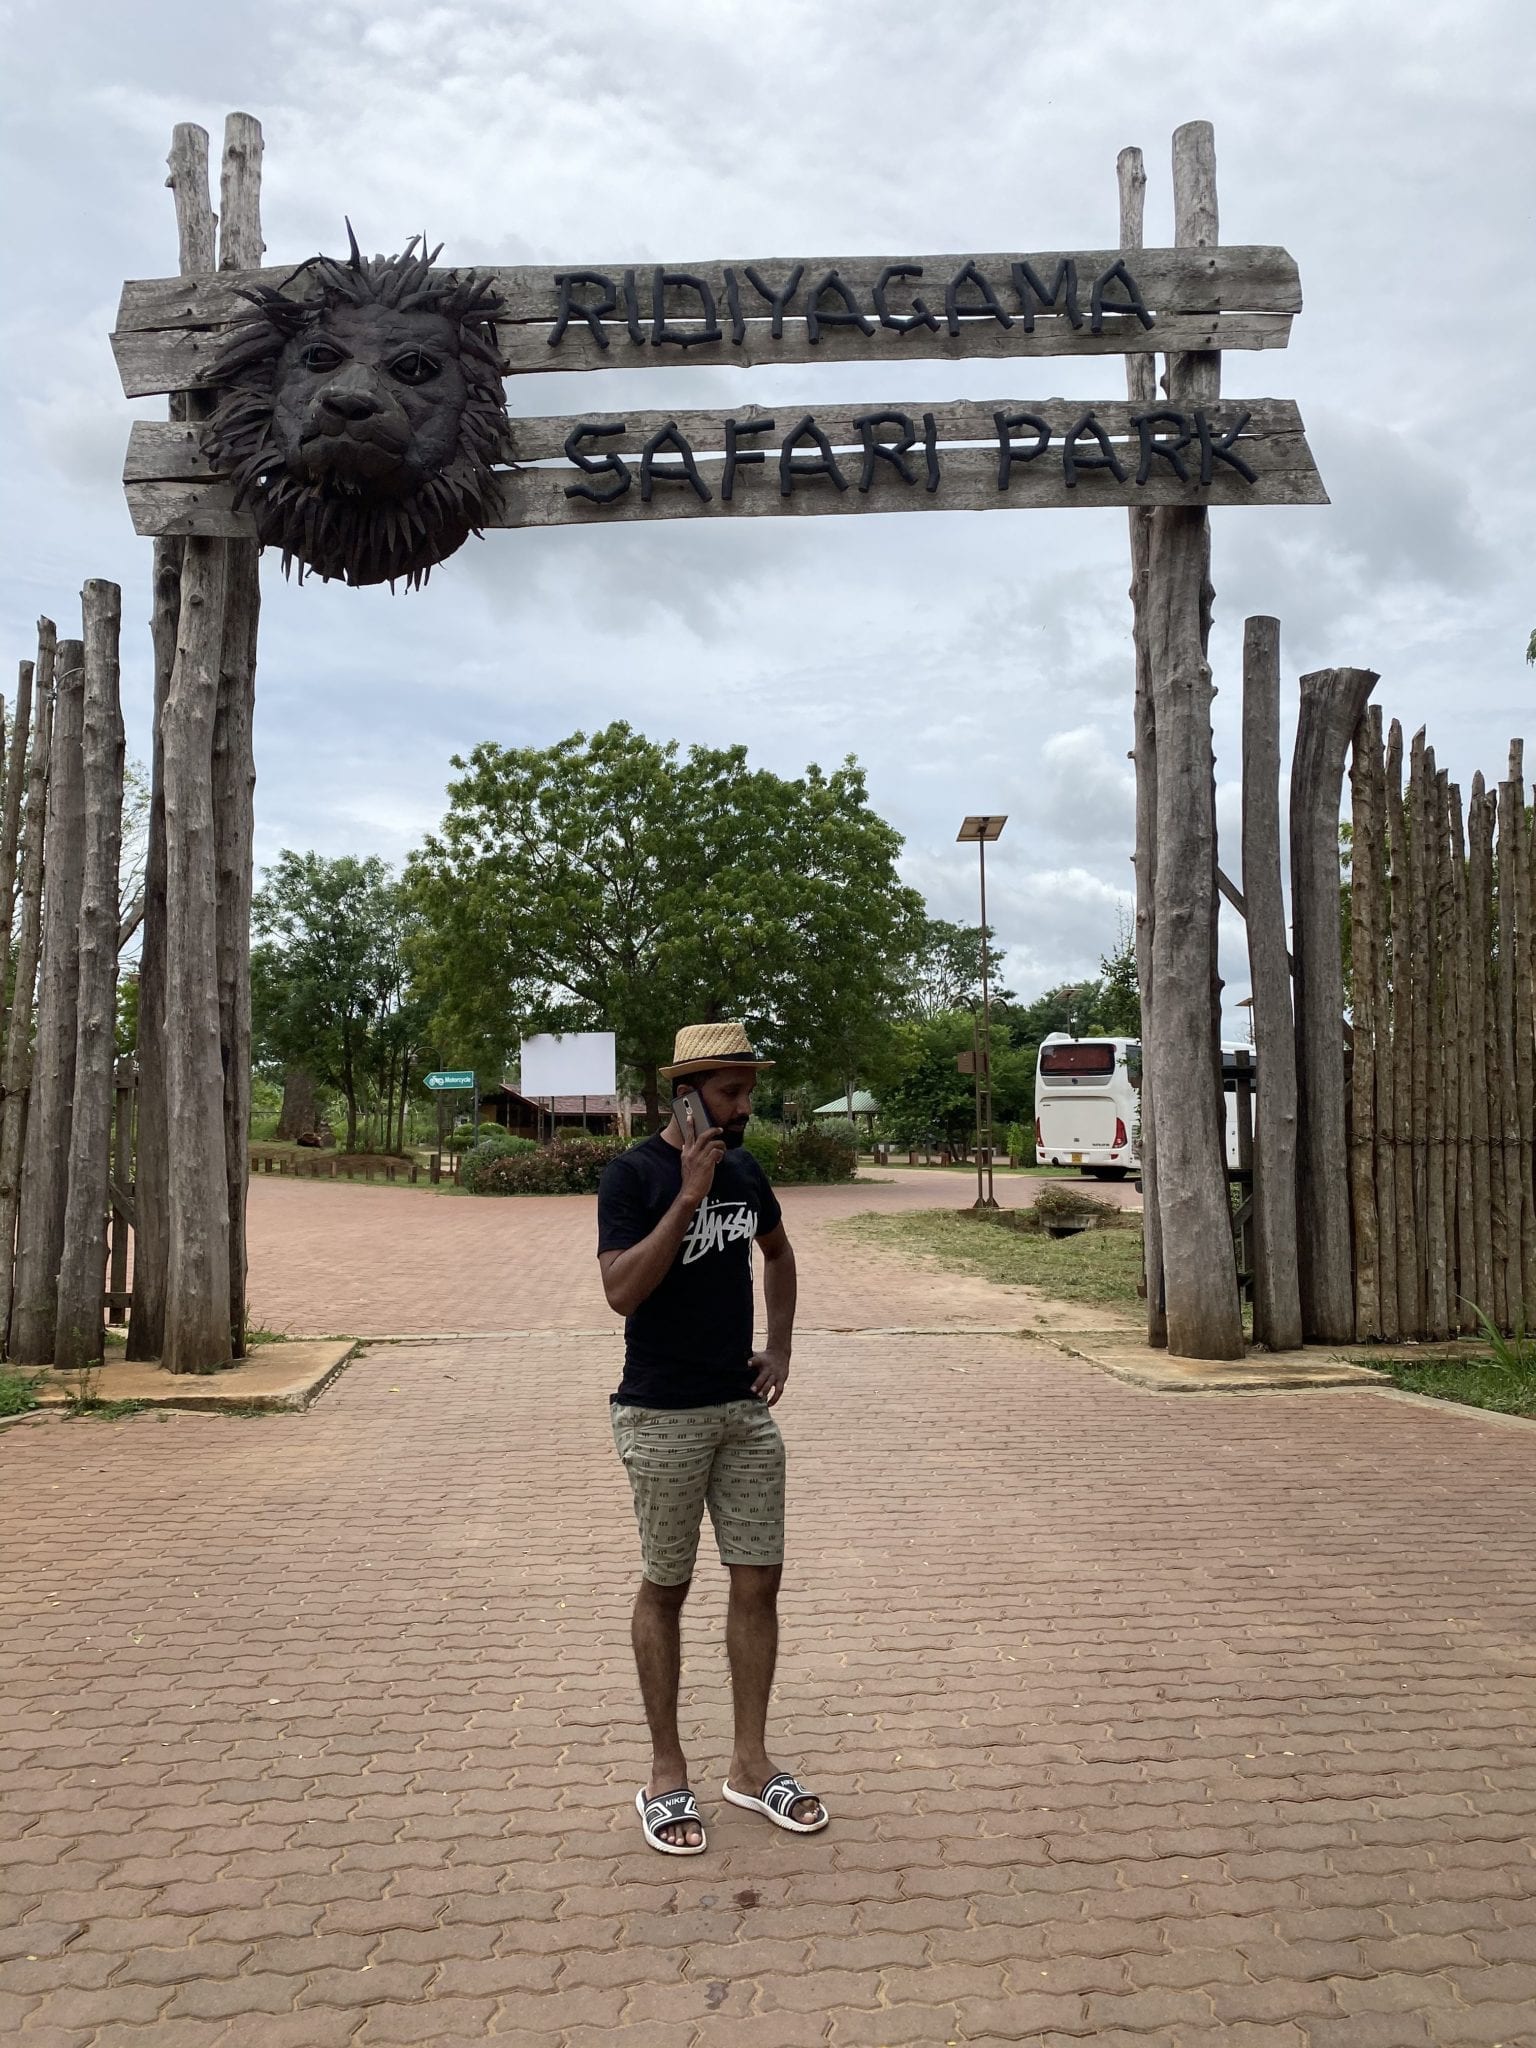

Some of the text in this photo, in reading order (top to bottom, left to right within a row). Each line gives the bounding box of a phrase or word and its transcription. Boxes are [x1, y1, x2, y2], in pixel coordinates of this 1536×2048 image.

[546, 259, 1156, 347] RIDIYAGAMA
[563, 409, 1259, 503] SAFARI PARK
[665, 1796, 687, 1807] NIKE
